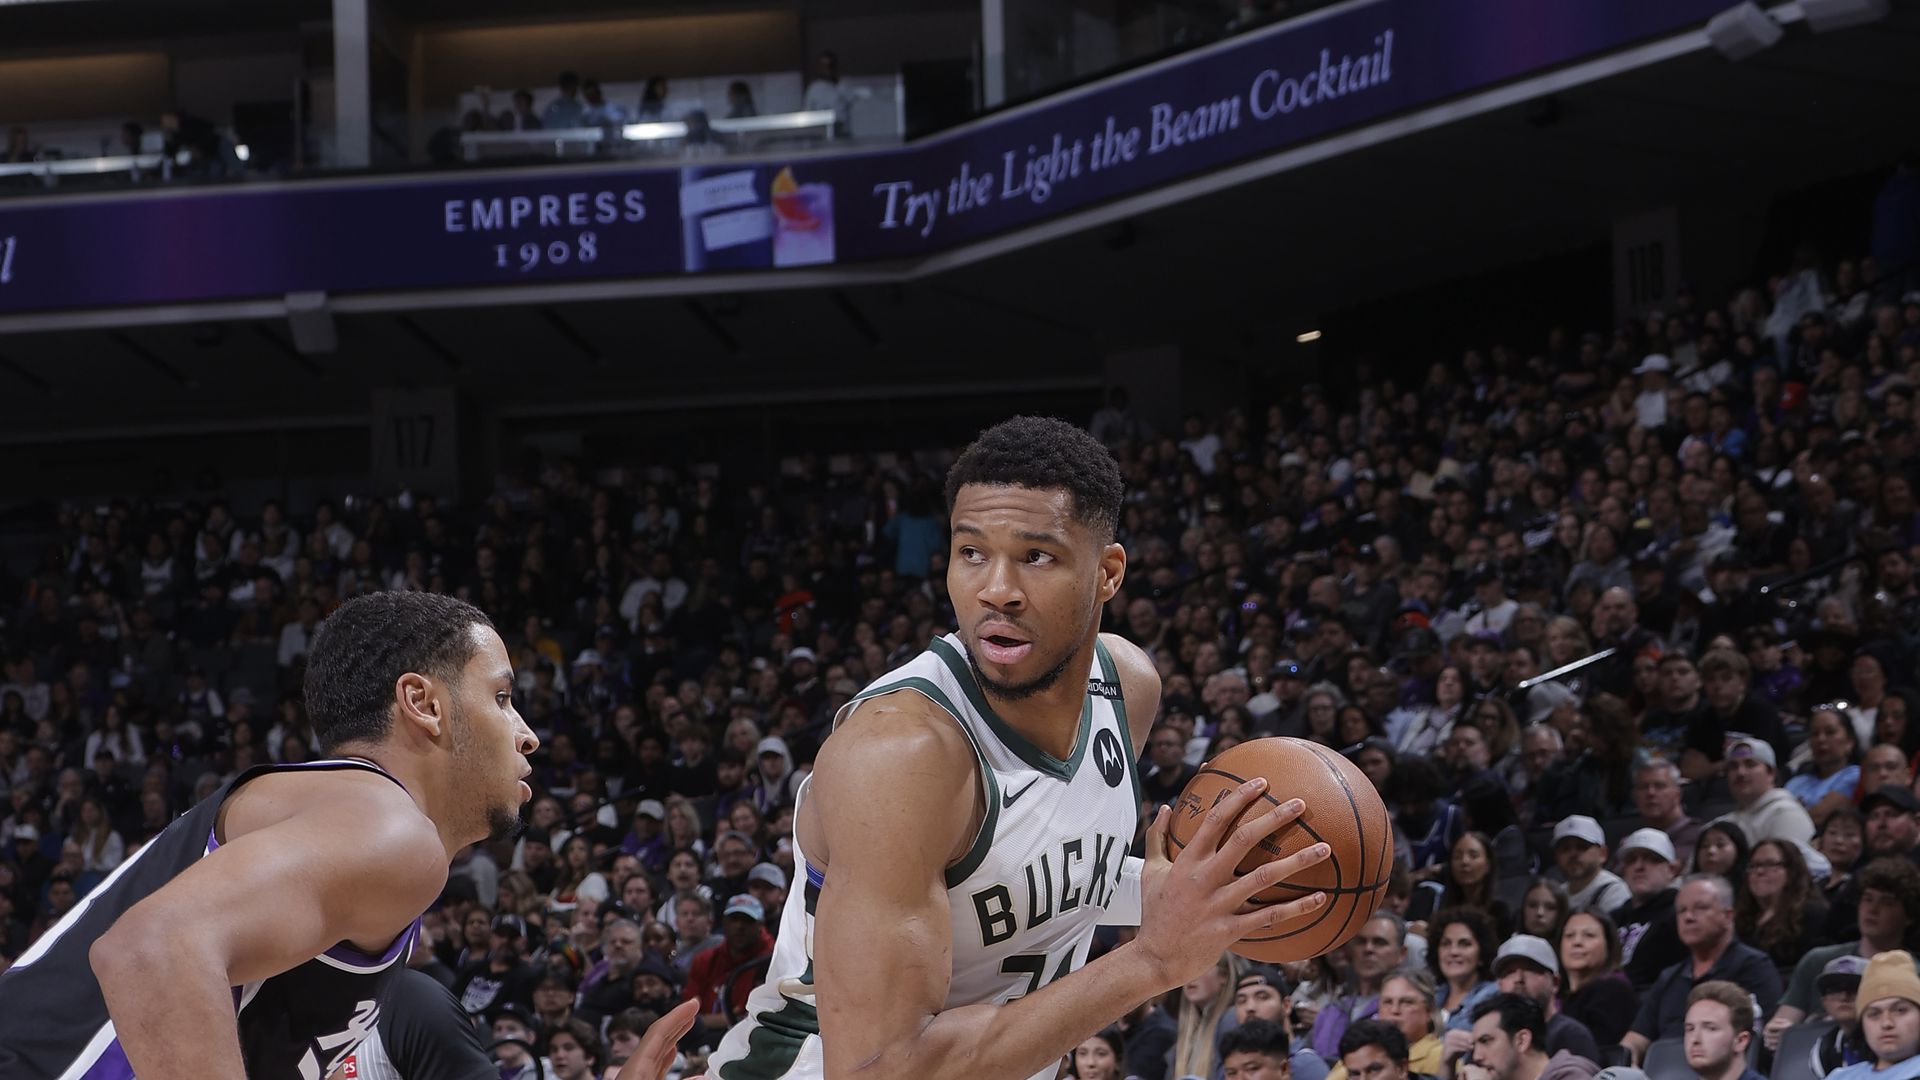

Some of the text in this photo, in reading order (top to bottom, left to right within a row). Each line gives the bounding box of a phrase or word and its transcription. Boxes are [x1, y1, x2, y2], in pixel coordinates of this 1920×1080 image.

[872, 30, 1395, 238] Try the Light the Beam Cocktail
[443, 189, 647, 234] EMPRESS
[494, 231, 600, 271] 1908
